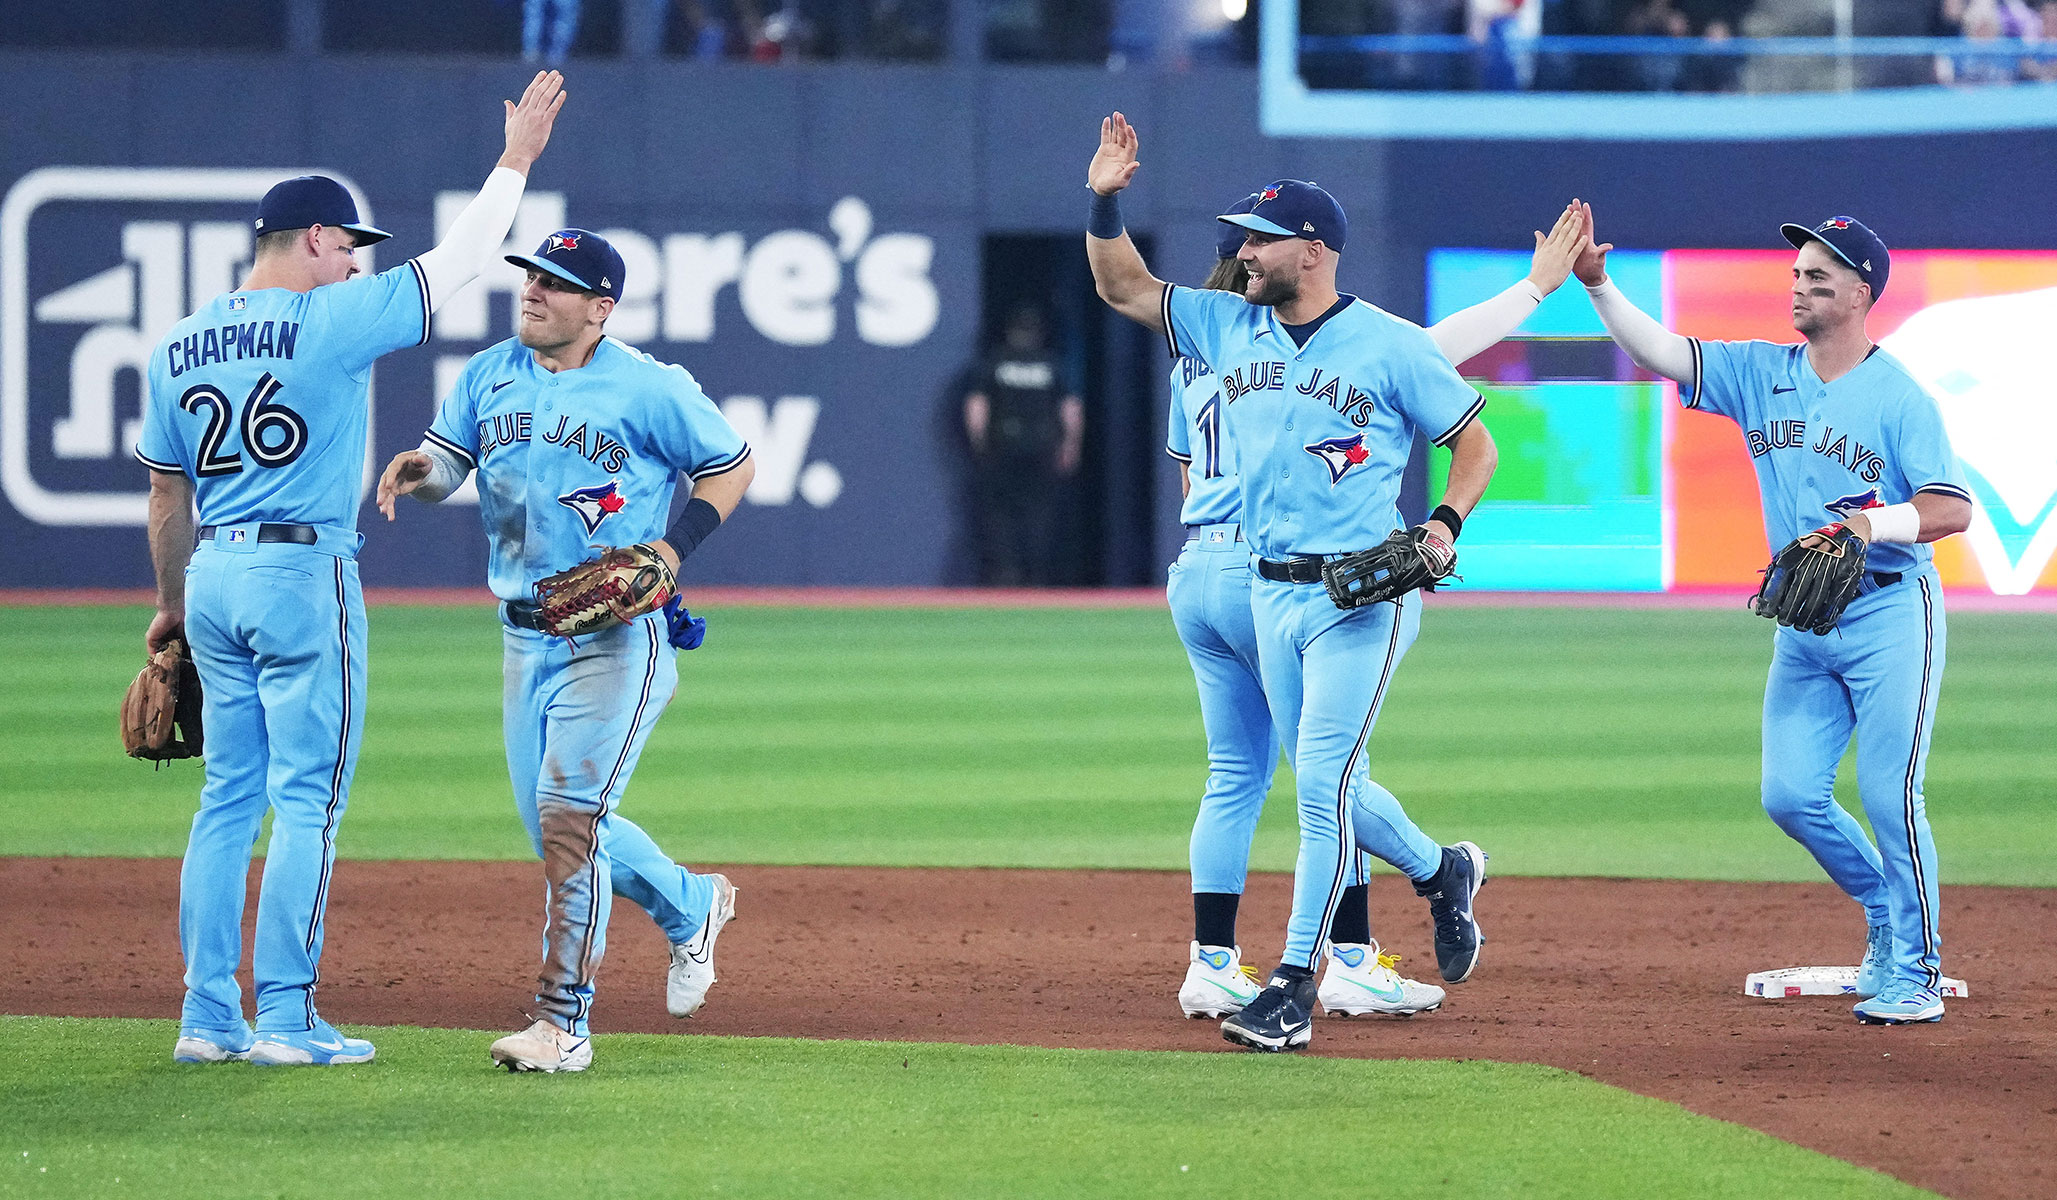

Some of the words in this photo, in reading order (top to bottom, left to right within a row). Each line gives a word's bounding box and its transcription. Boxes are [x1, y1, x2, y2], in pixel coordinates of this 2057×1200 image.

[433, 190, 940, 347] Here's
[168, 321, 299, 378] CHAPMAN
[1182, 357, 1214, 388] BIC
[180, 371, 309, 478] 26
[1223, 361, 1285, 405] BLUE
[1296, 368, 1374, 427] JAYS
[542, 415, 630, 474] JAYS
[1196, 391, 1226, 480] 1
[1812, 426, 1886, 482] JAYS
